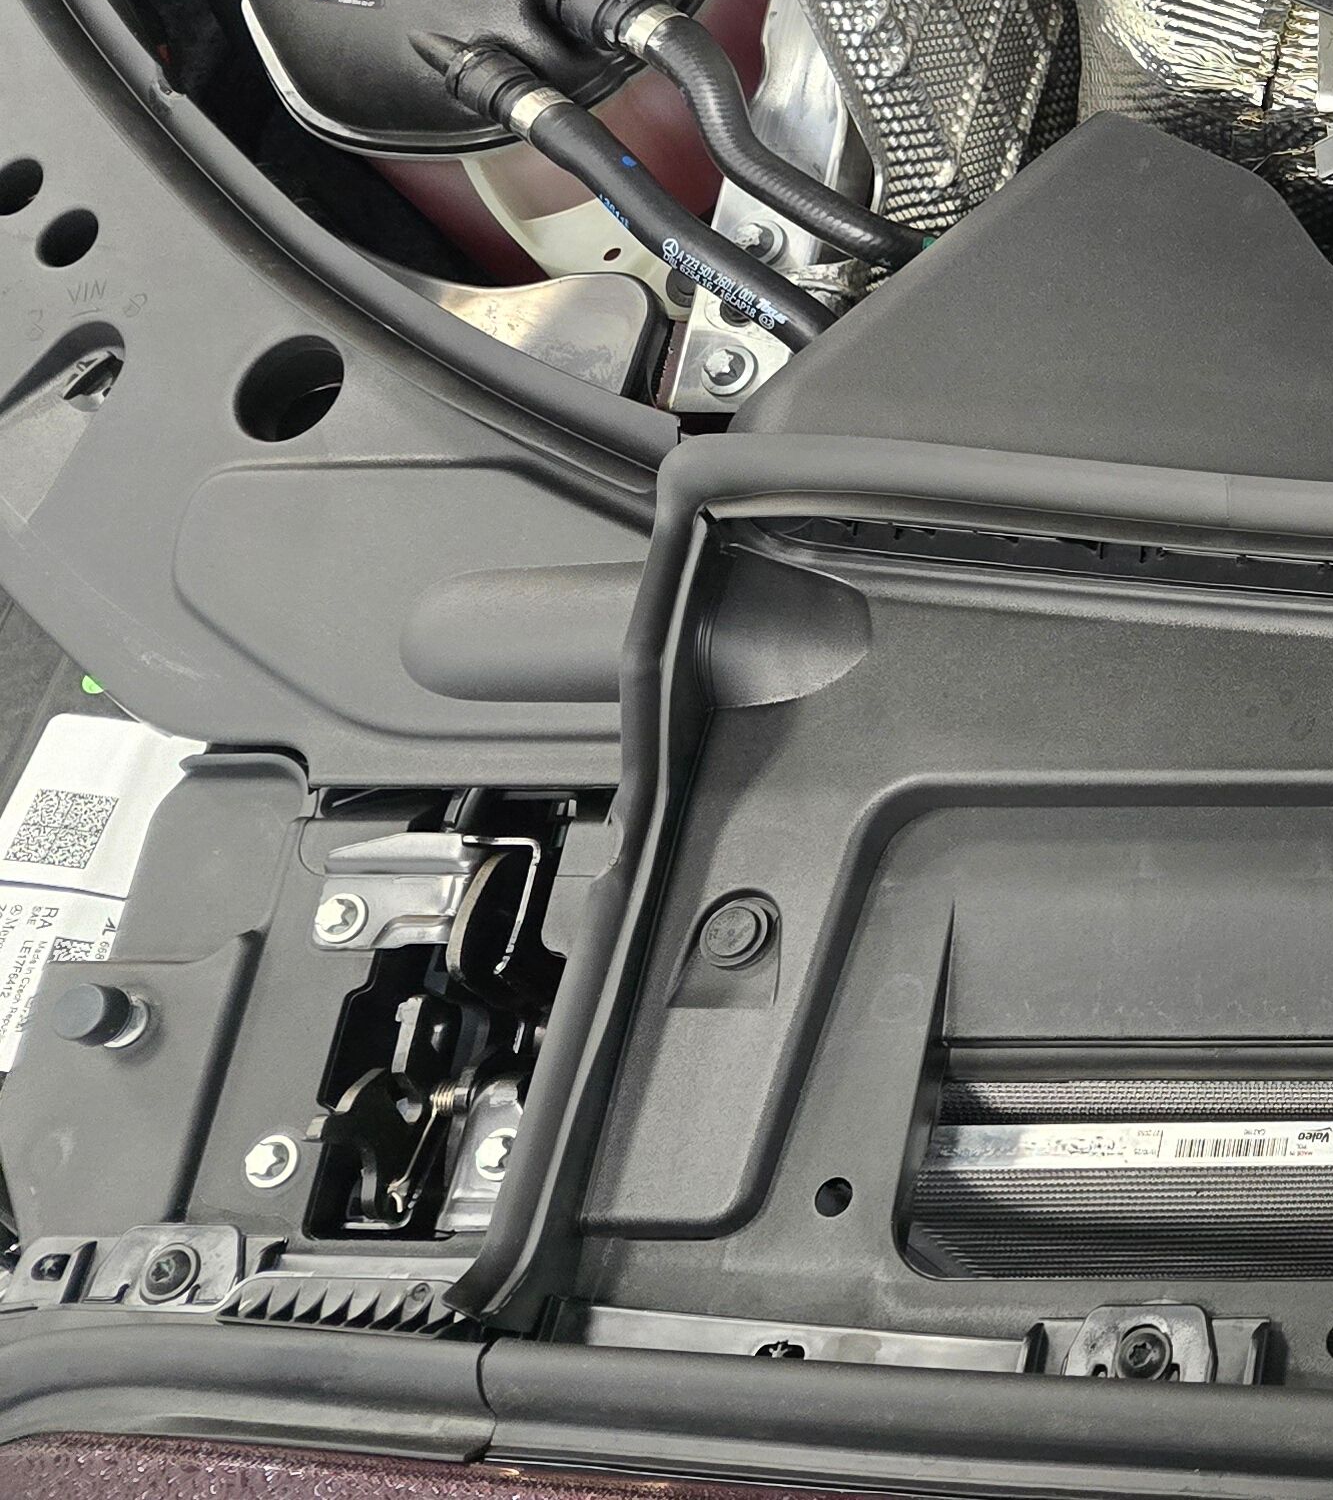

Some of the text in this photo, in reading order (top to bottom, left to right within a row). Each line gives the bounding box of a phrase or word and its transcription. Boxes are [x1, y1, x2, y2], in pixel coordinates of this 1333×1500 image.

[675, 250, 685, 263] A
[683, 251, 700, 272] 223
[699, 263, 718, 284] 501
[26, 906, 42, 926] SAE
[35, 905, 60, 930] RA
[12, 977, 31, 1005] Czech
[1297, 1131, 1331, 1144] Valeo
